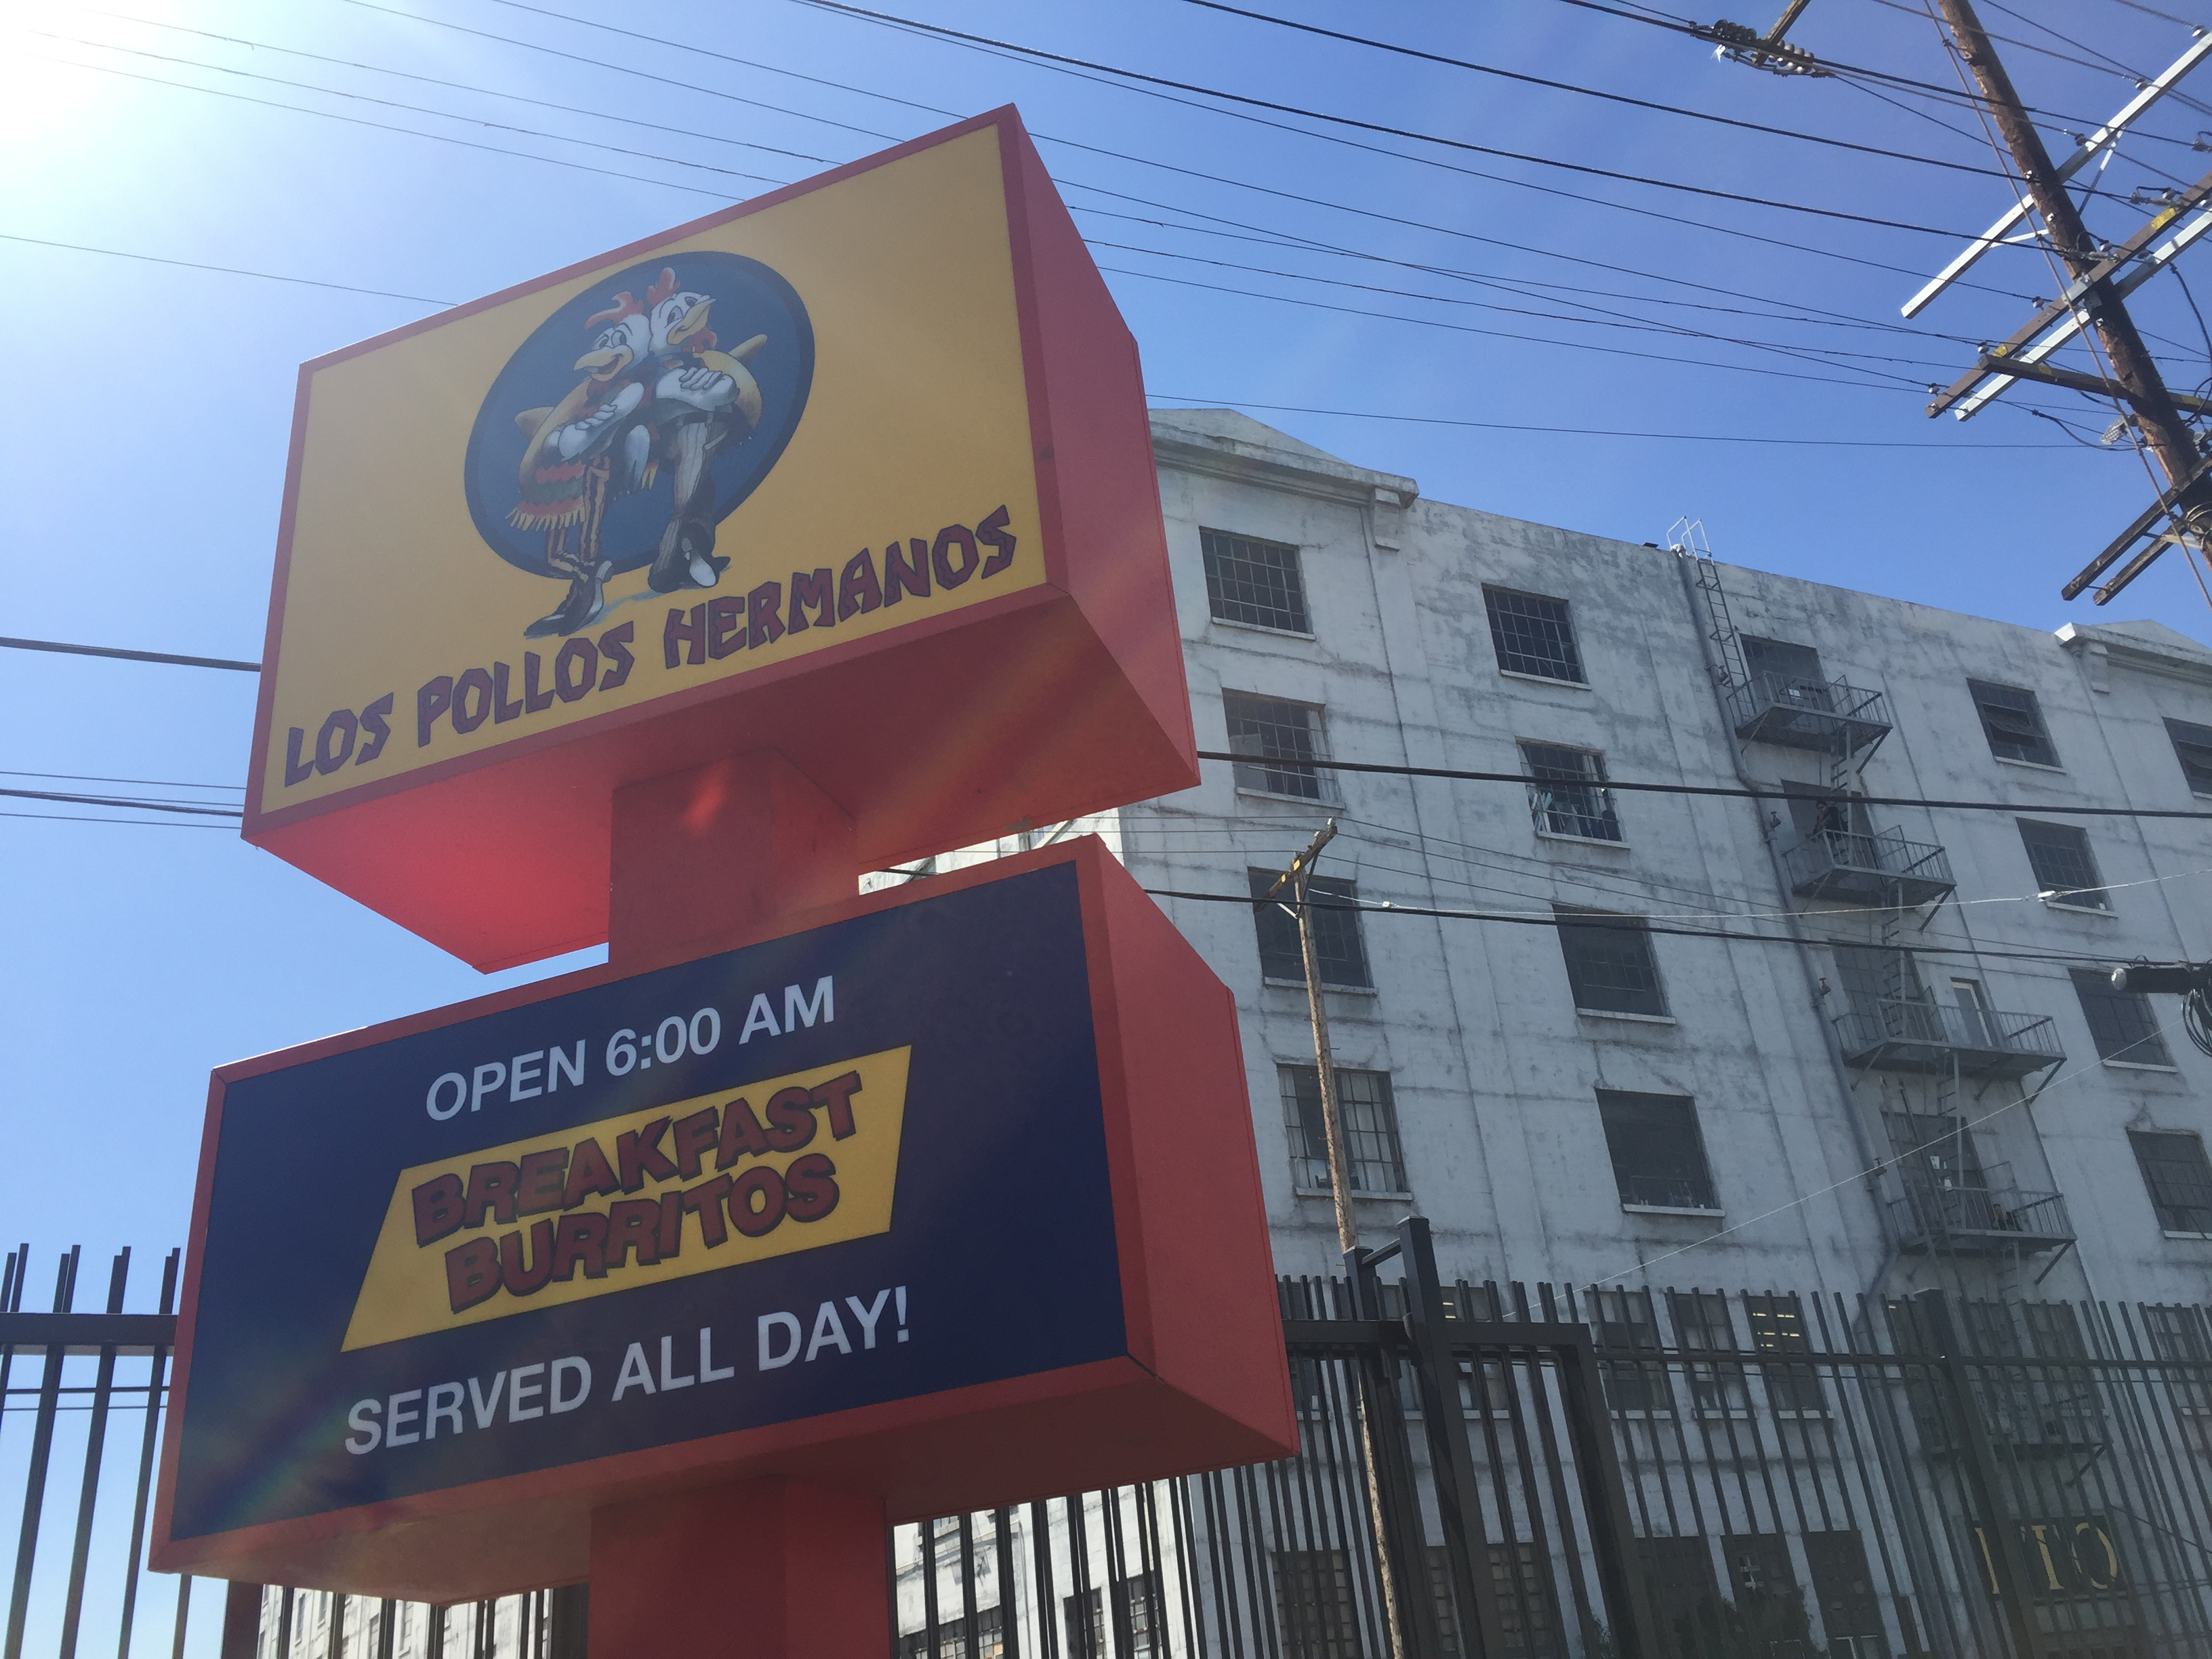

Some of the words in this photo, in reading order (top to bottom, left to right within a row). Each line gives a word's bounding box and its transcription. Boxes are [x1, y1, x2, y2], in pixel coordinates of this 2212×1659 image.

[284, 692, 394, 787] LOS
[417, 621, 635, 747] POLLOS
[663, 504, 1017, 670] HERMANOS
[426, 1040, 586, 1121] OPEN
[605, 1006, 722, 1077] 6:00
[739, 975, 835, 1044] AM
[411, 1071, 863, 1248] BREAKFAST
[444, 1153, 840, 1314] BURRITOS
[344, 1355, 592, 1456] SERVED
[611, 1326, 735, 1402] ALL
[757, 1285, 909, 1372] DAY!
